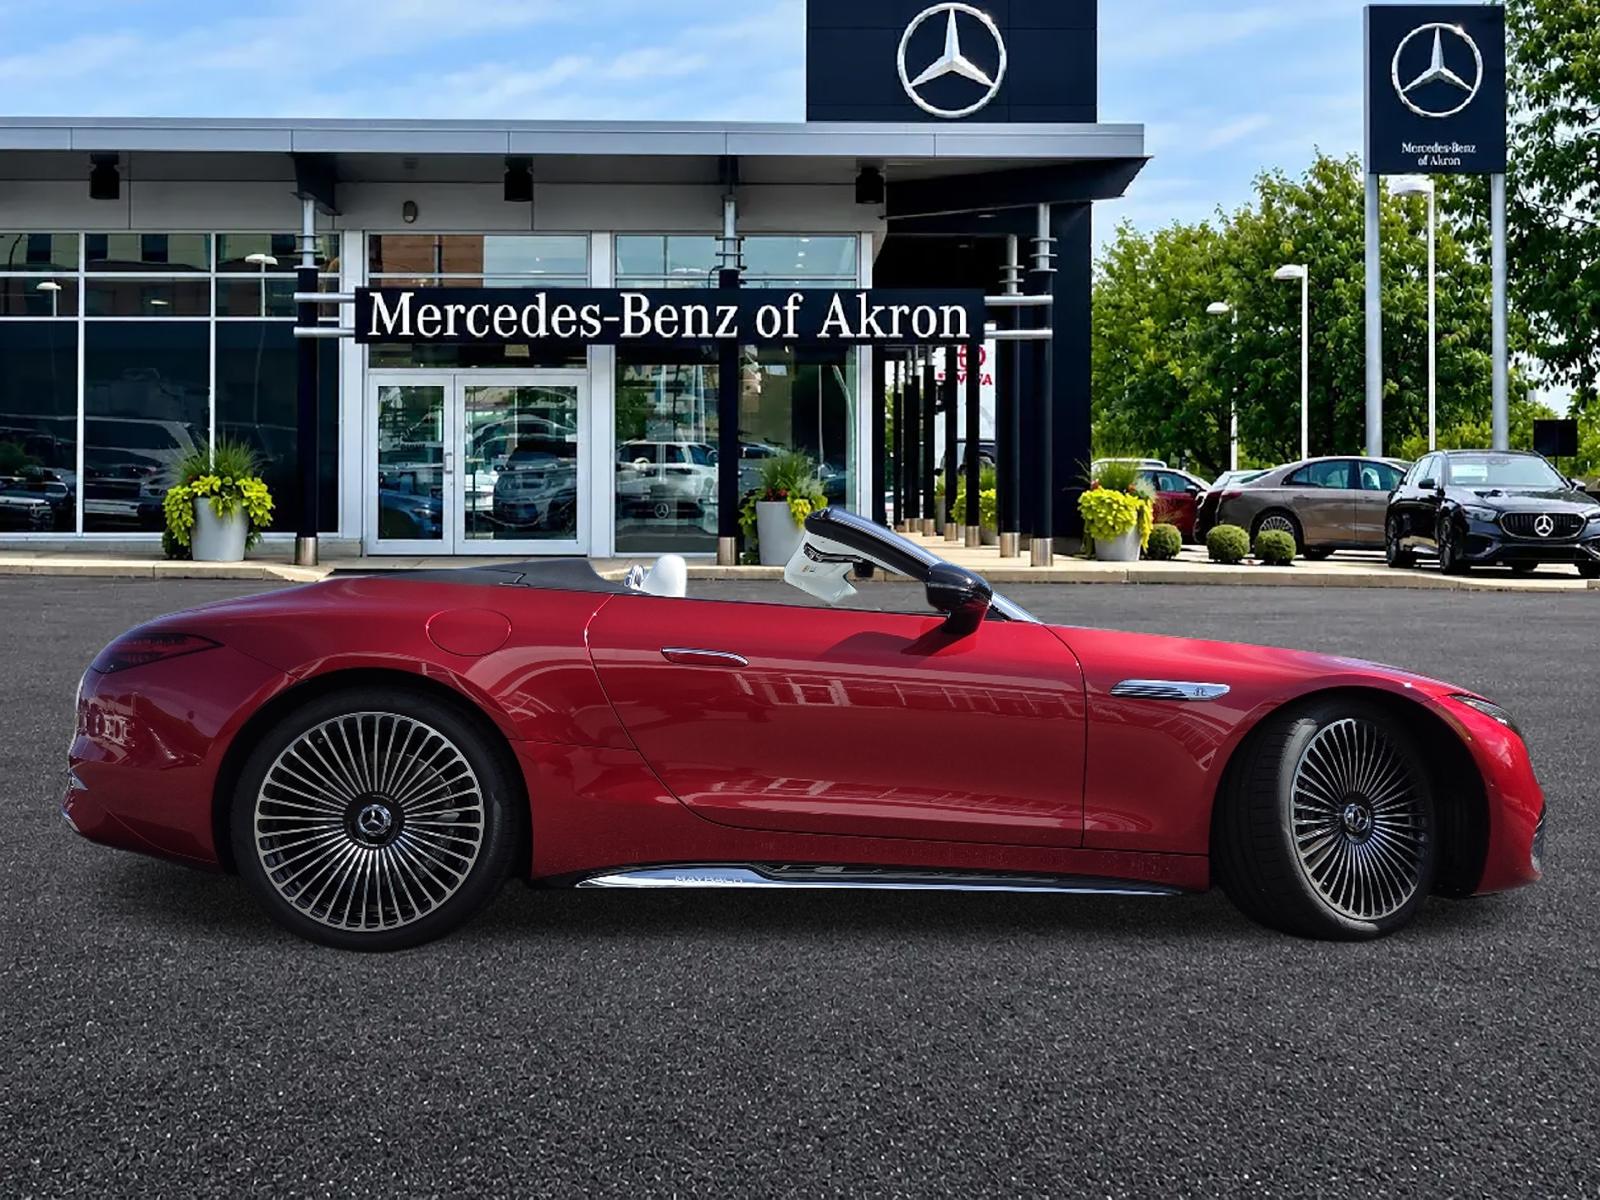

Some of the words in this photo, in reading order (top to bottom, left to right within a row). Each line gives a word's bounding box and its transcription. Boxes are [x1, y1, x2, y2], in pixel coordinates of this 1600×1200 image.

[1401, 142, 1476, 153] Mercedes-Benz
[1417, 154, 1428, 166] of
[1430, 154, 1461, 166] Akron
[367, 291, 738, 338] Mercedes-Benz
[755, 292, 803, 338] of
[816, 291, 970, 338] Akron
